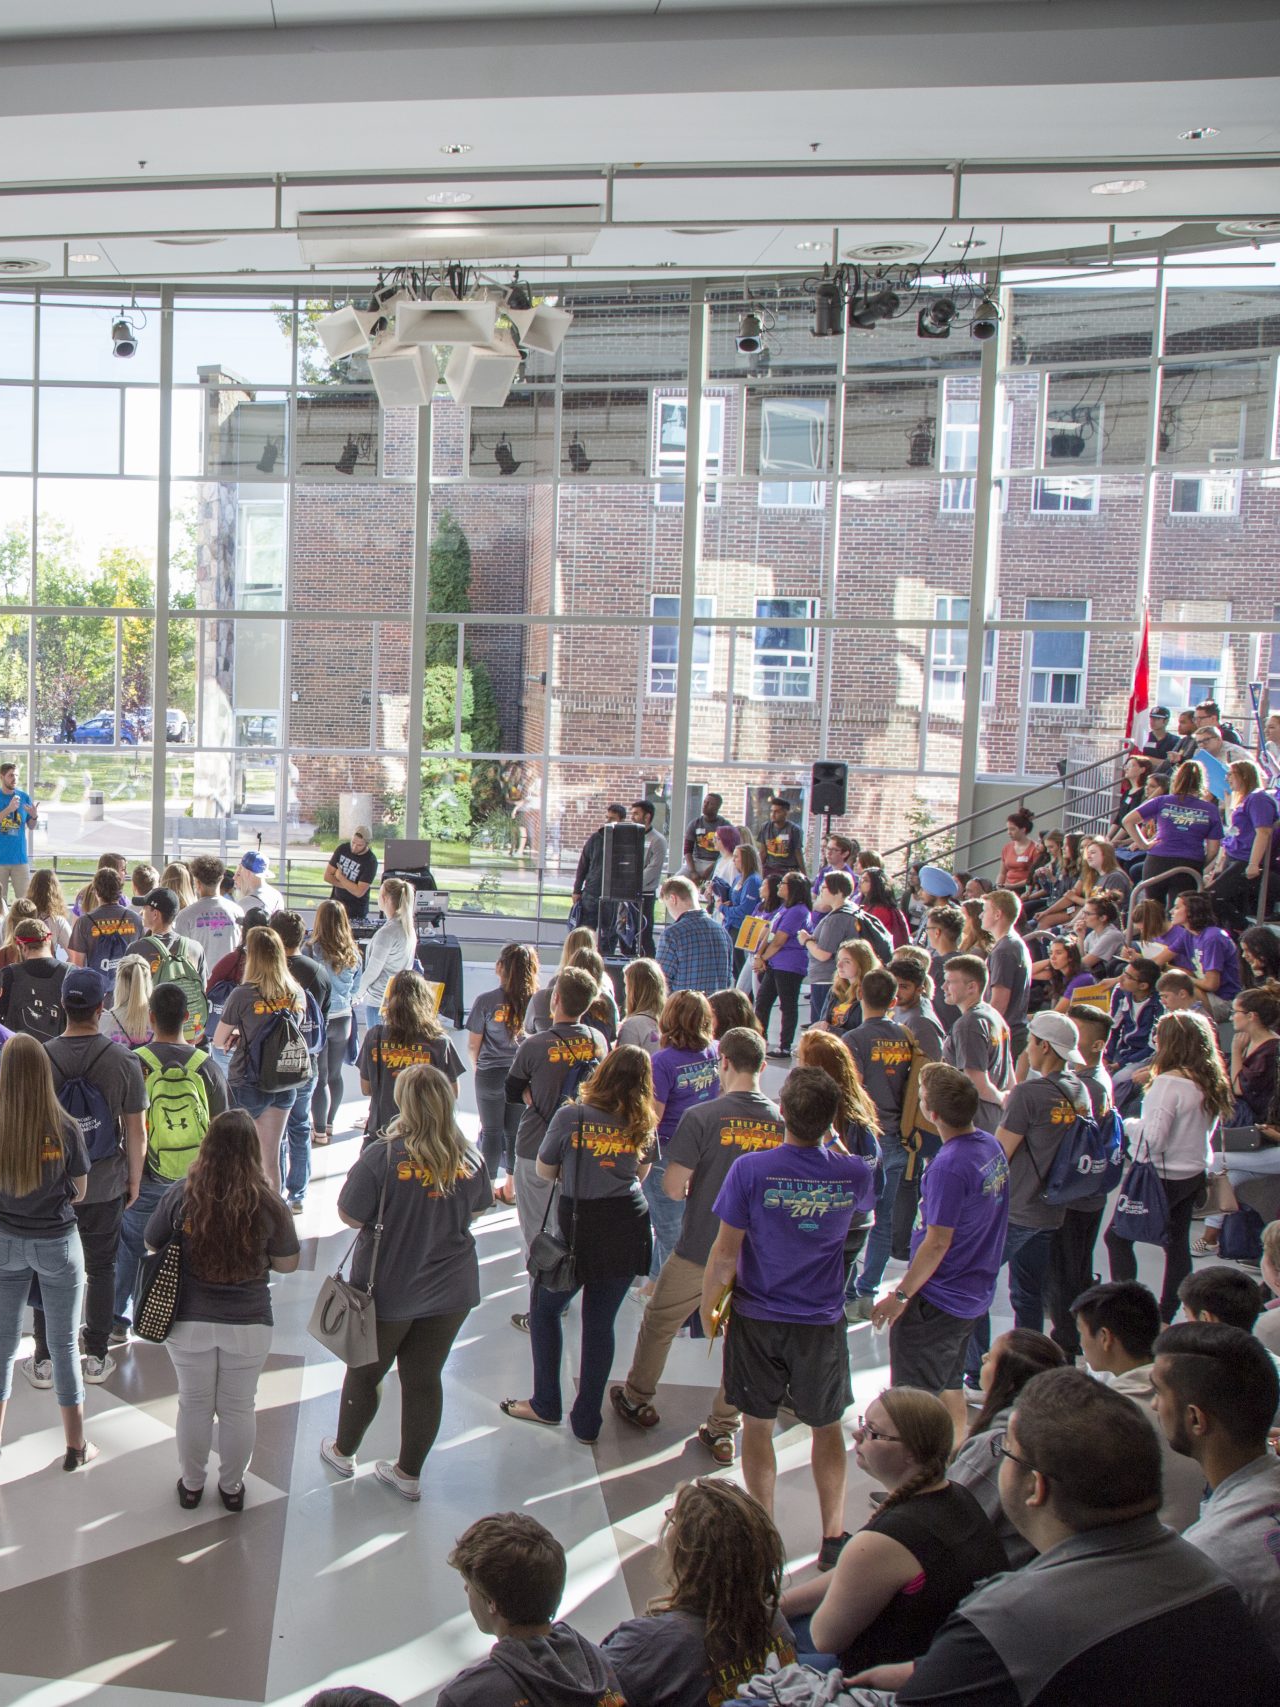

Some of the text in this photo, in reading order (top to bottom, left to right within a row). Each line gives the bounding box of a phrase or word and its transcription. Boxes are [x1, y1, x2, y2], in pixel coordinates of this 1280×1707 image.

[381, 1042, 423, 1051] HUNER
[548, 1044, 594, 1062] STOR
[730, 1120, 776, 1132] THUNDER
[720, 1126, 784, 1148] STORM
[592, 1141, 619, 1158] 2017
[778, 1181, 843, 1192] THUNDER
[763, 1189, 858, 1209] STORM
[790, 1204, 829, 1218] 2017
